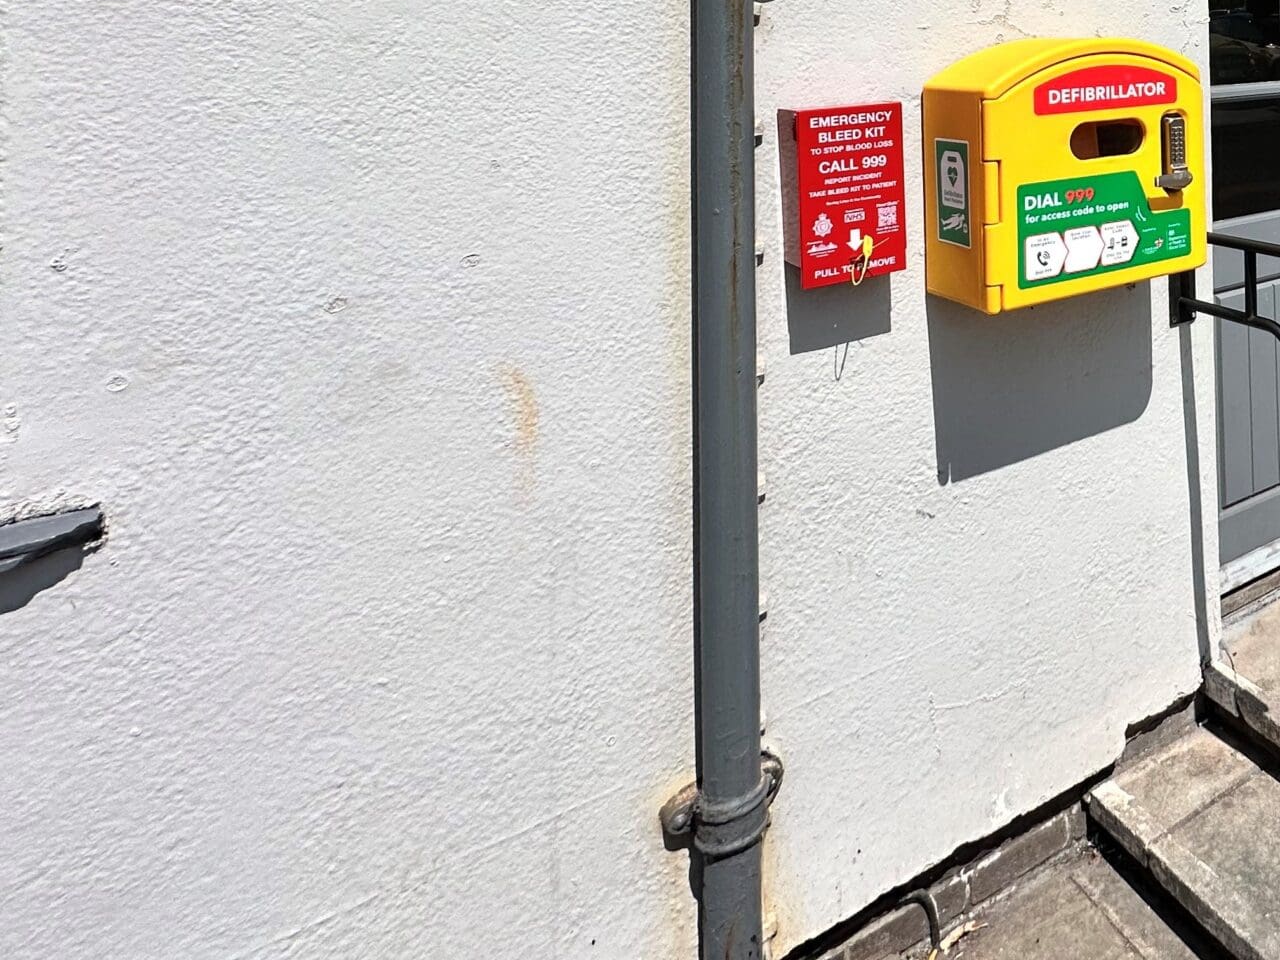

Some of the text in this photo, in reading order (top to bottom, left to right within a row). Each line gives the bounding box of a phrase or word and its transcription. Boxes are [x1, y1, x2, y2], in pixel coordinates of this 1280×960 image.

[1048, 82, 1166, 105] DEFIBRILLATOR
[809, 110, 893, 129] EMERGENCY
[818, 126, 886, 144] BLEED KIT
[810, 139, 894, 156] TO STOP BLOOD LOSS
[818, 154, 887, 174] CALL 999
[824, 172, 883, 185] REPORT INCIDENT
[808, 190, 827, 198] TAKE
[827, 187, 850, 196] BLEED
[862, 183, 871, 191] TO
[871, 180, 897, 189] PATIENT
[1024, 187, 1094, 211] DIAL 999
[846, 213, 864, 221] NHS
[1025, 201, 1130, 225] for access code to open
[814, 267, 840, 280] PULL
[841, 263, 855, 274] TO
